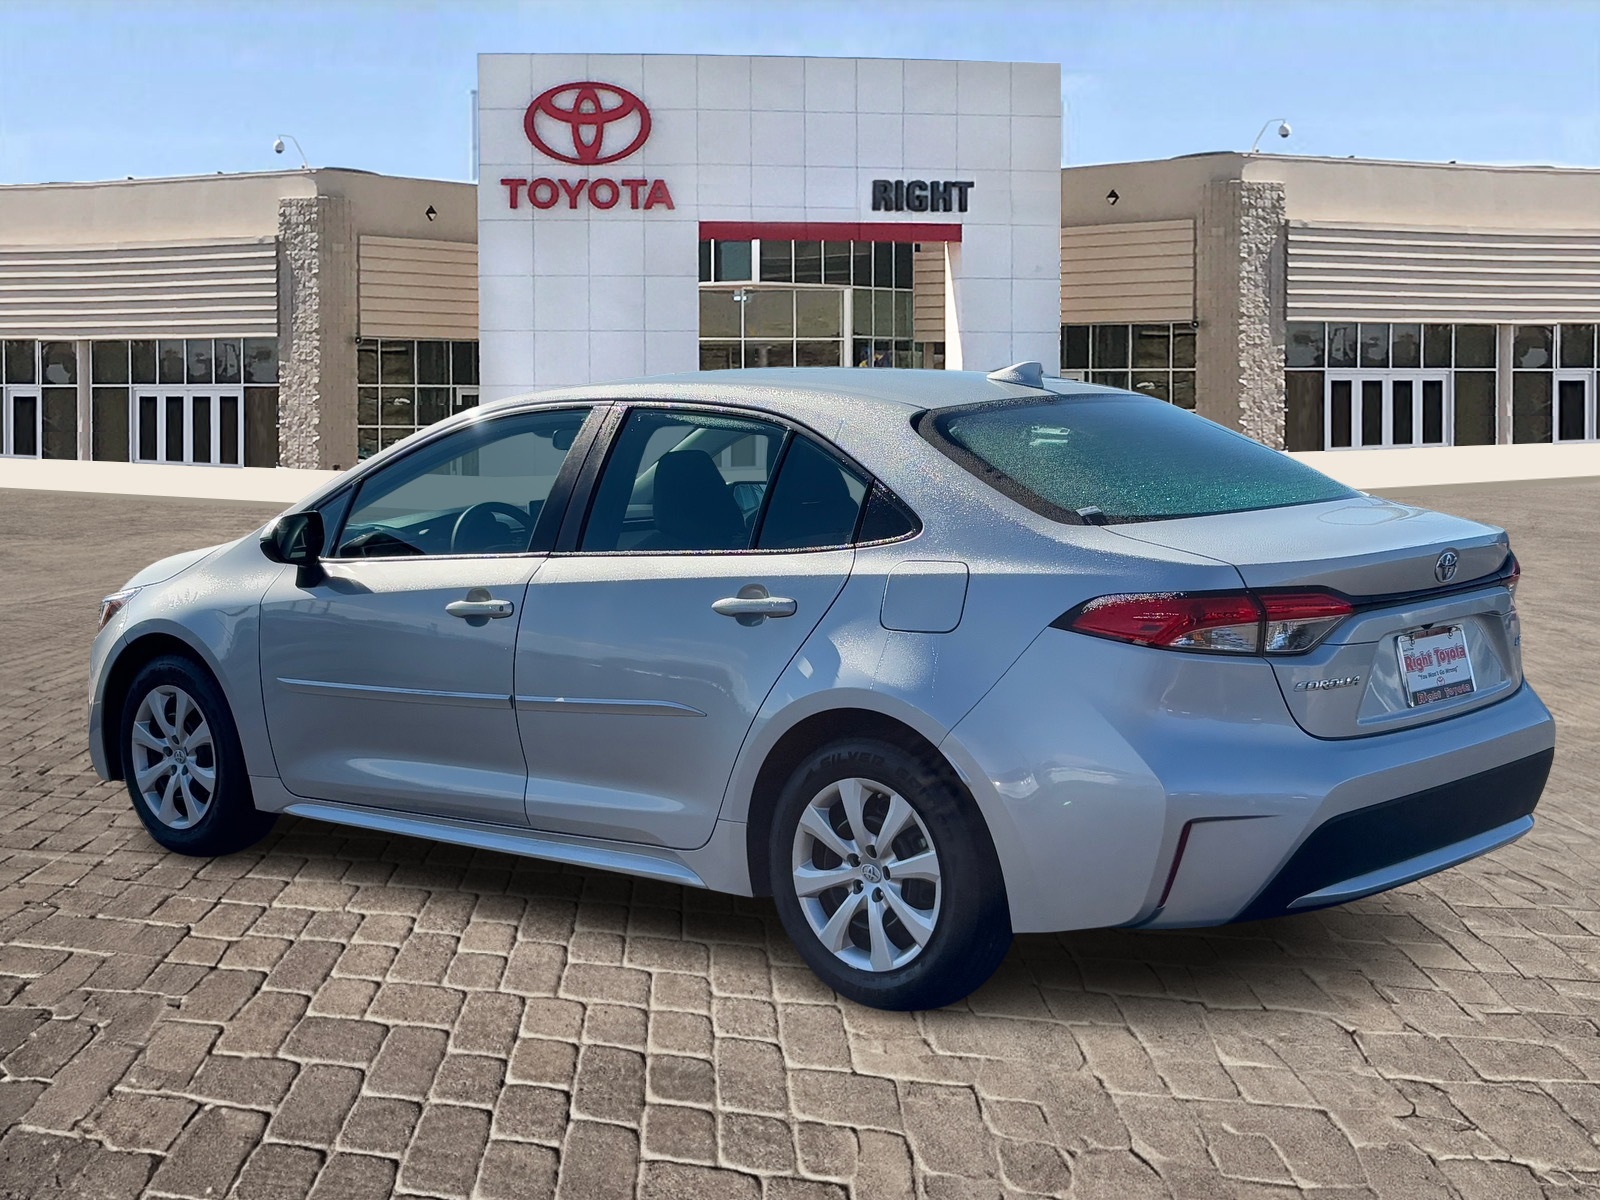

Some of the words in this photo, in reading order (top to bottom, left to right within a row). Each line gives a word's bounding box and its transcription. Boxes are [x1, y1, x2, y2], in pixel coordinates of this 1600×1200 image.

[500, 177, 675, 210] TOYOTA
[871, 179, 974, 213] RIGHT
[1404, 651, 1433, 673] Right
[1433, 644, 1466, 666] Toyota
[1293, 674, 1360, 692] COROLLA
